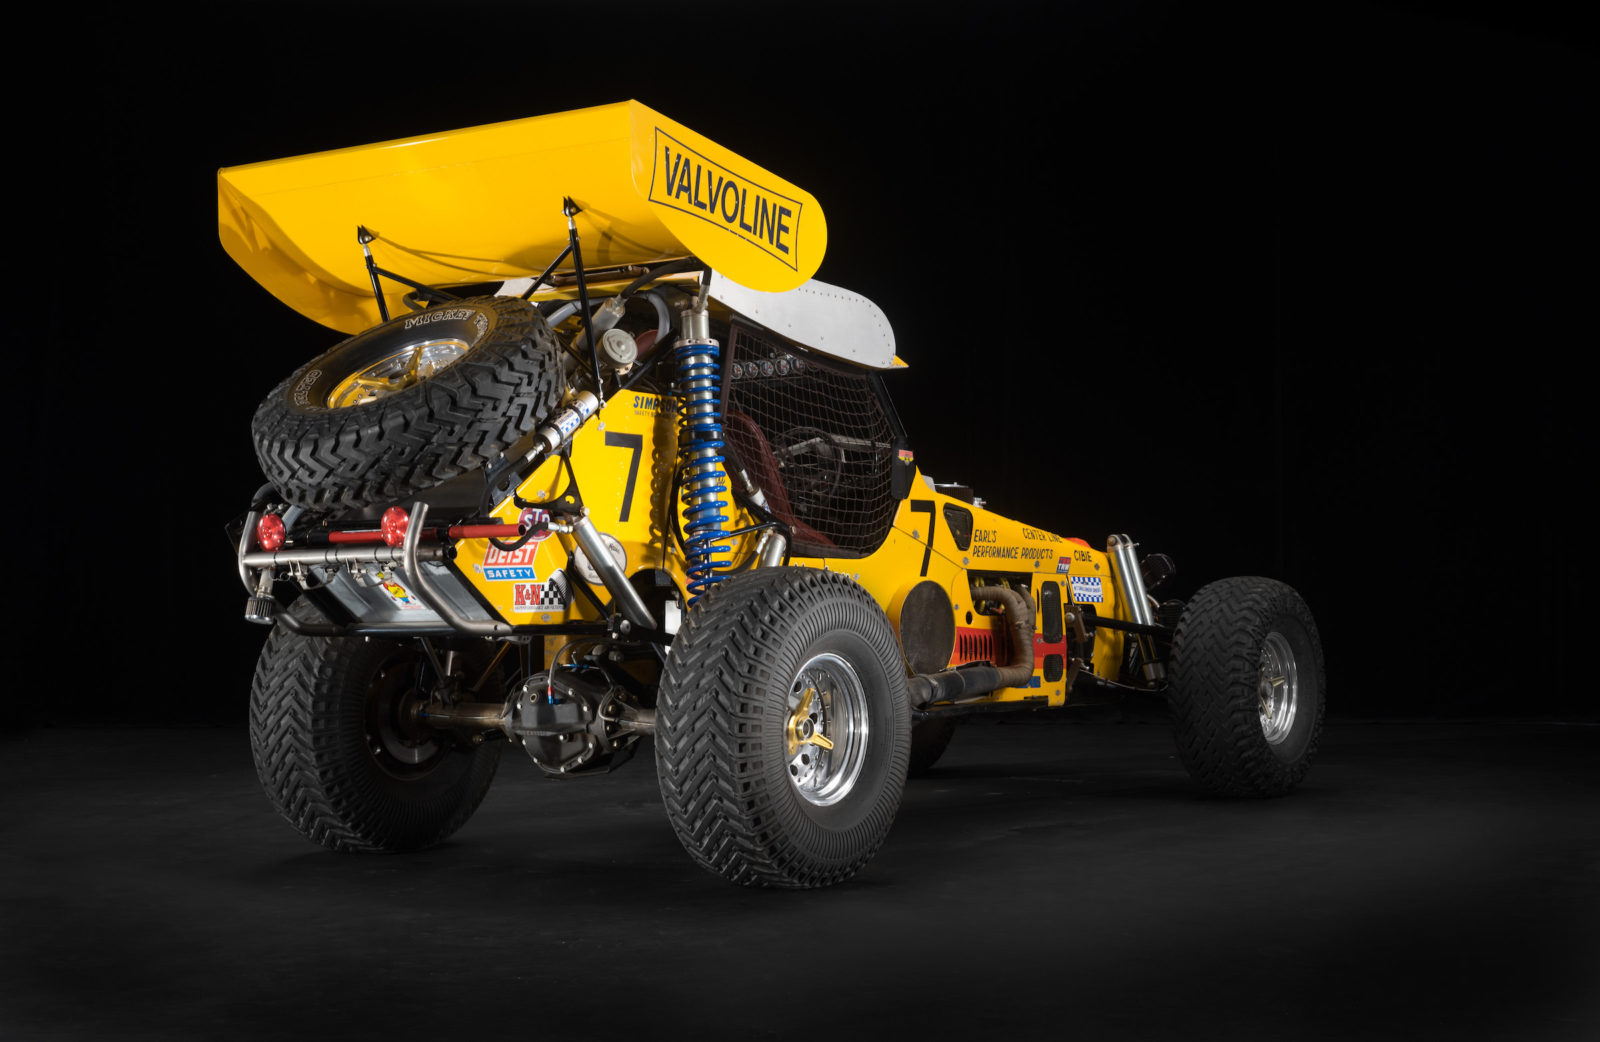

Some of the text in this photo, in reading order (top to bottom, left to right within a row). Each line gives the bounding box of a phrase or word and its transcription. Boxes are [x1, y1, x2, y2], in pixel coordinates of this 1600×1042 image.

[665, 145, 792, 255] VALVOLINE
[404, 308, 476, 330] MICKEY
[633, 395, 678, 413] SIMPSON
[605, 430, 643, 522] 7
[910, 499, 936, 577] 7
[973, 529, 997, 543] EARL'S
[1022, 527, 1063, 543] CENTER LINE
[487, 544, 535, 564] DEIST
[972, 545, 1054, 560] PERFORMANCE PRODUCTS
[1074, 550, 1092, 562] CIBIE
[486, 569, 532, 578] SAFETY
[515, 585, 542, 605] K&N
